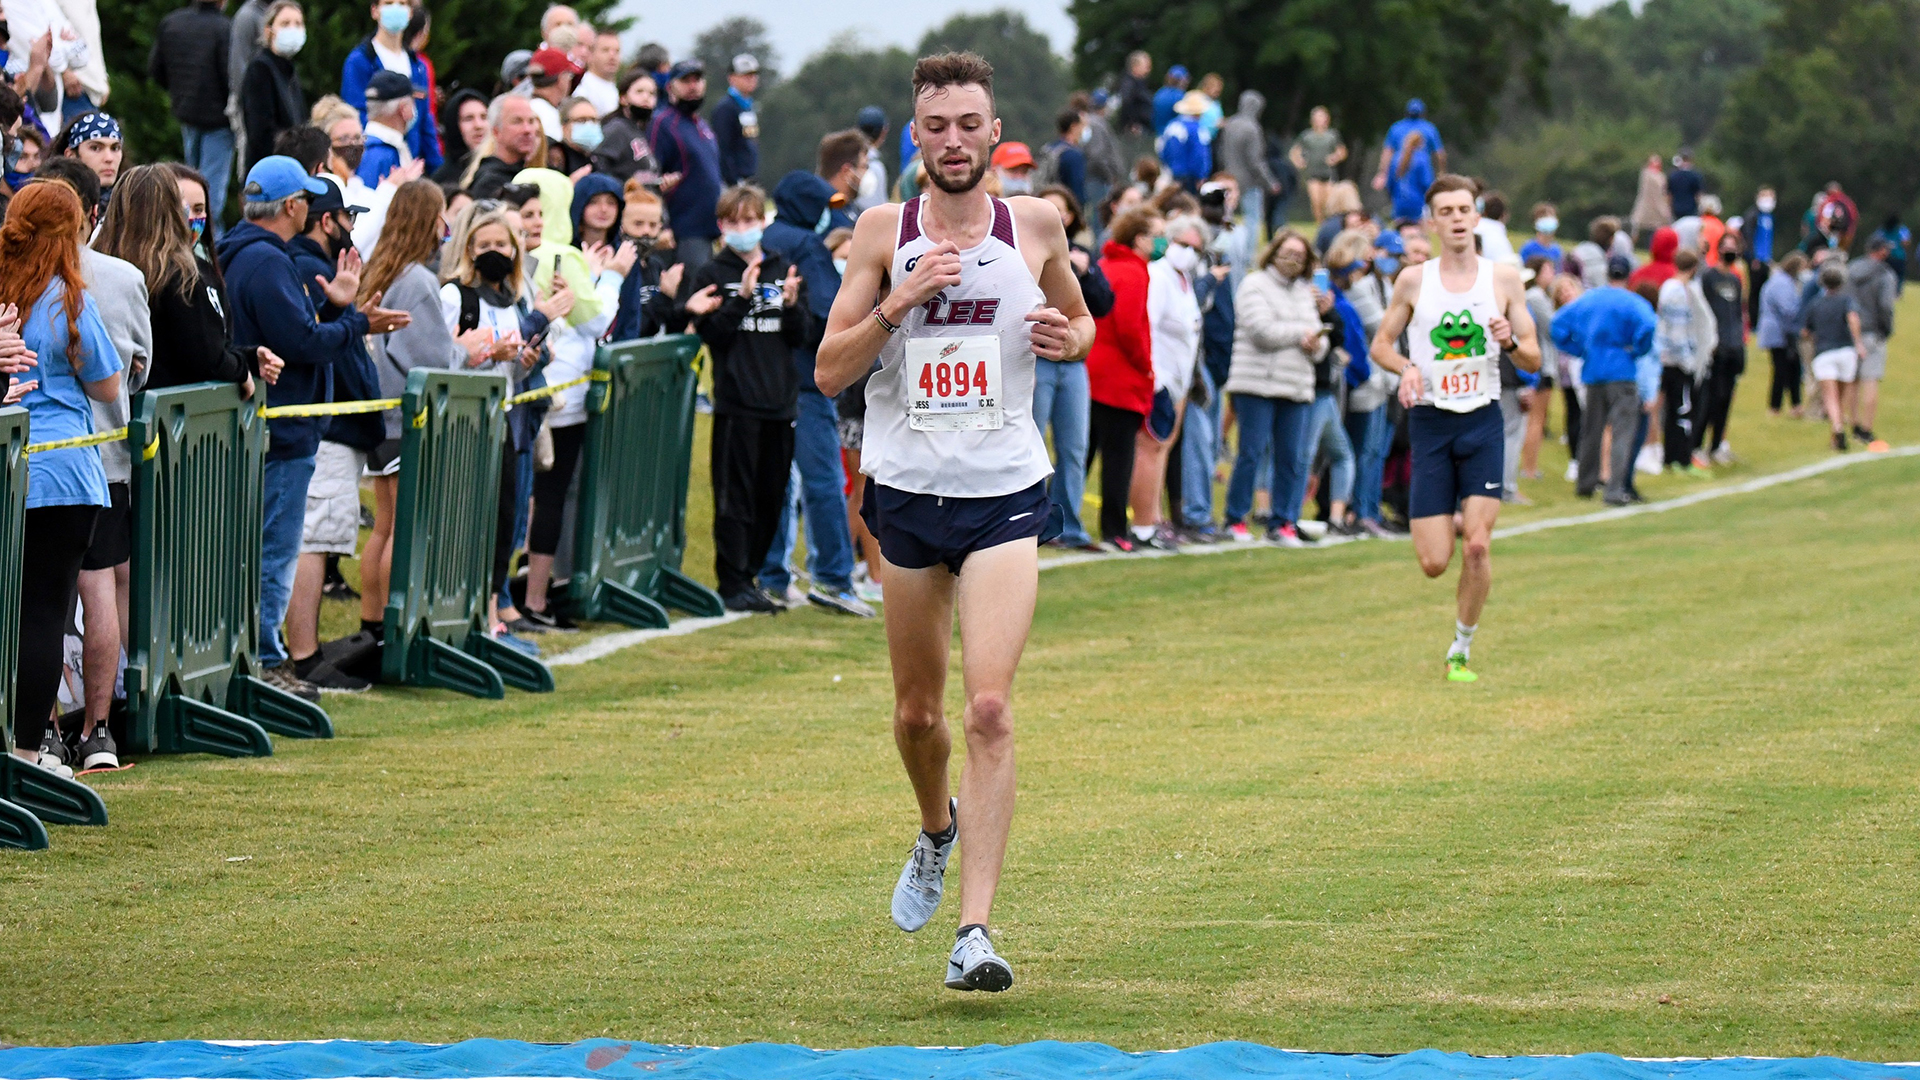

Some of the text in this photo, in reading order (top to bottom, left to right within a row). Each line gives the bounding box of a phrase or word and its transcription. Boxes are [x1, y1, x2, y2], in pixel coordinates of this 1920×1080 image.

[924, 298, 1001, 326] LEE
[919, 361, 988, 398] 4894
[1441, 371, 1479, 395] 4937
[915, 400, 930, 409] JESS
